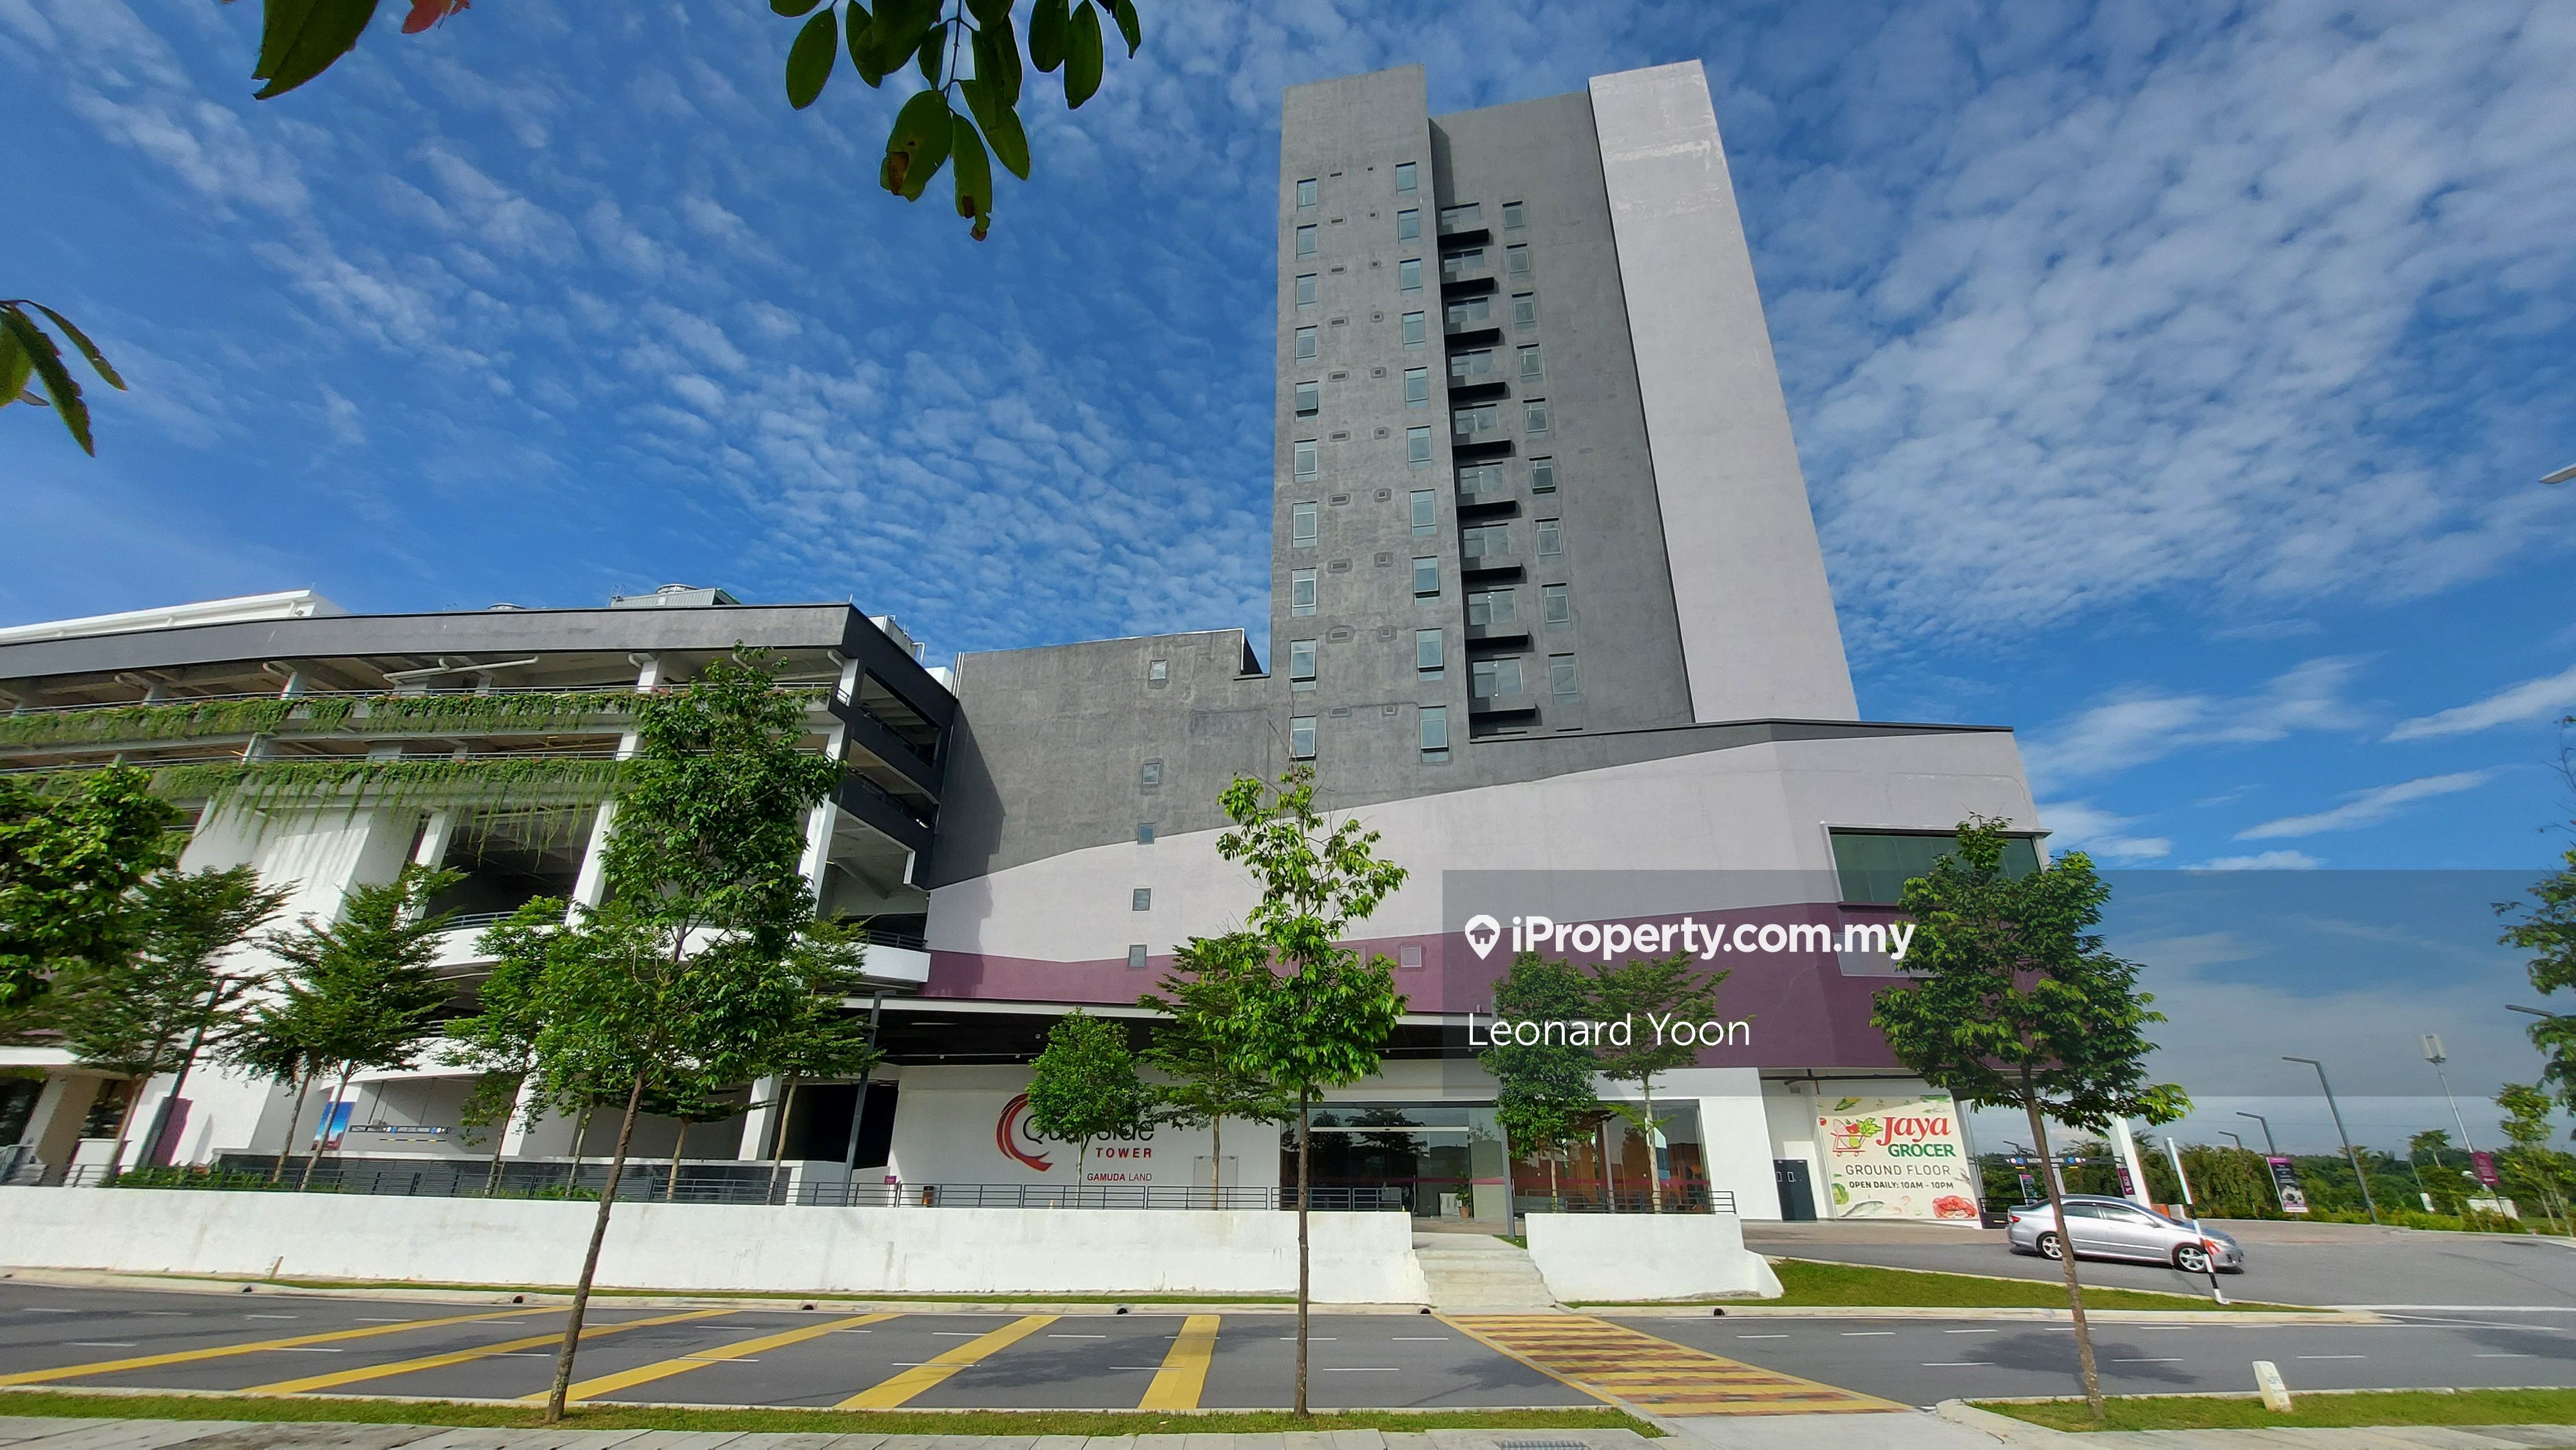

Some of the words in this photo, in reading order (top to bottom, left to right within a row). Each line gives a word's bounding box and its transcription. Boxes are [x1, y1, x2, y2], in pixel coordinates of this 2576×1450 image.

[1876, 1117, 1951, 1145] Jaya
[1096, 1148, 1151, 1158] TOWER
[1888, 1144, 1956, 1157] GROCER
[1846, 1165, 1901, 1175] GROUND
[1907, 1165, 1951, 1175] FLOOR
